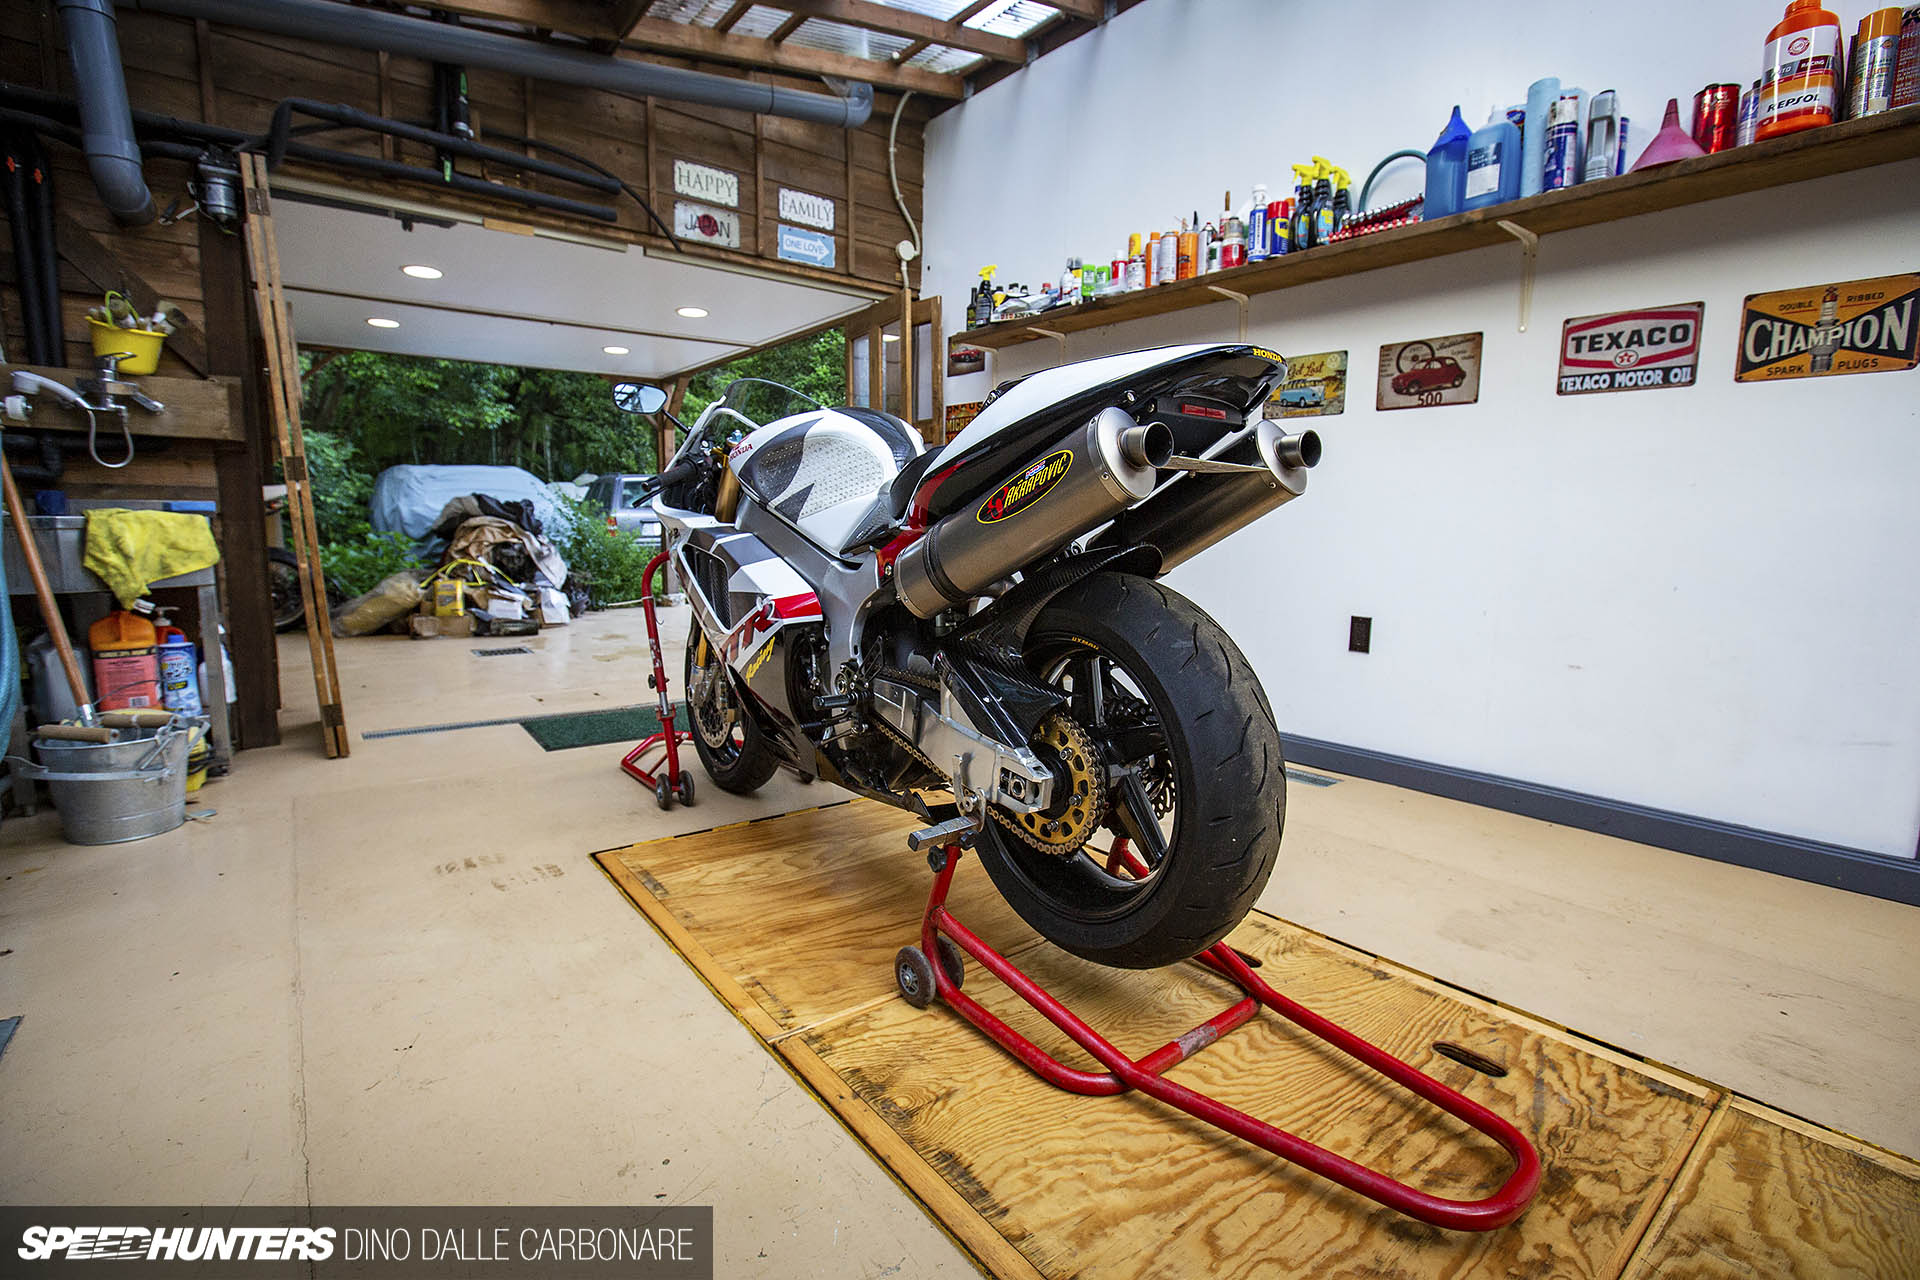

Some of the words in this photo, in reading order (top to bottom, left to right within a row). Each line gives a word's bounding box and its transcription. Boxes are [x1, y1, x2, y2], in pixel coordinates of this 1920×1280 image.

[1767, 94, 1820, 112] REPSOL
[678, 167, 735, 197] HAPPY
[782, 194, 832, 222] FAMILY
[685, 214, 730, 238] JAPAN
[785, 238, 802, 250] ONE
[803, 240, 825, 255] LOVE
[1778, 300, 1813, 311] DOUBLE
[1846, 291, 1885, 303] RIBBED
[1571, 323, 1690, 355] TEXACO
[1747, 298, 1915, 363] CHAMPION
[1252, 348, 1282, 363] HONDA
[1303, 361, 1324, 377] Lost
[1766, 364, 1804, 377] SPARK
[1837, 358, 1879, 370] PLUGS
[1560, 372, 1609, 391] TEXACO
[1614, 369, 1663, 387] MOTOR
[1669, 366, 1692, 383] OIL
[1418, 392, 1442, 406] 500
